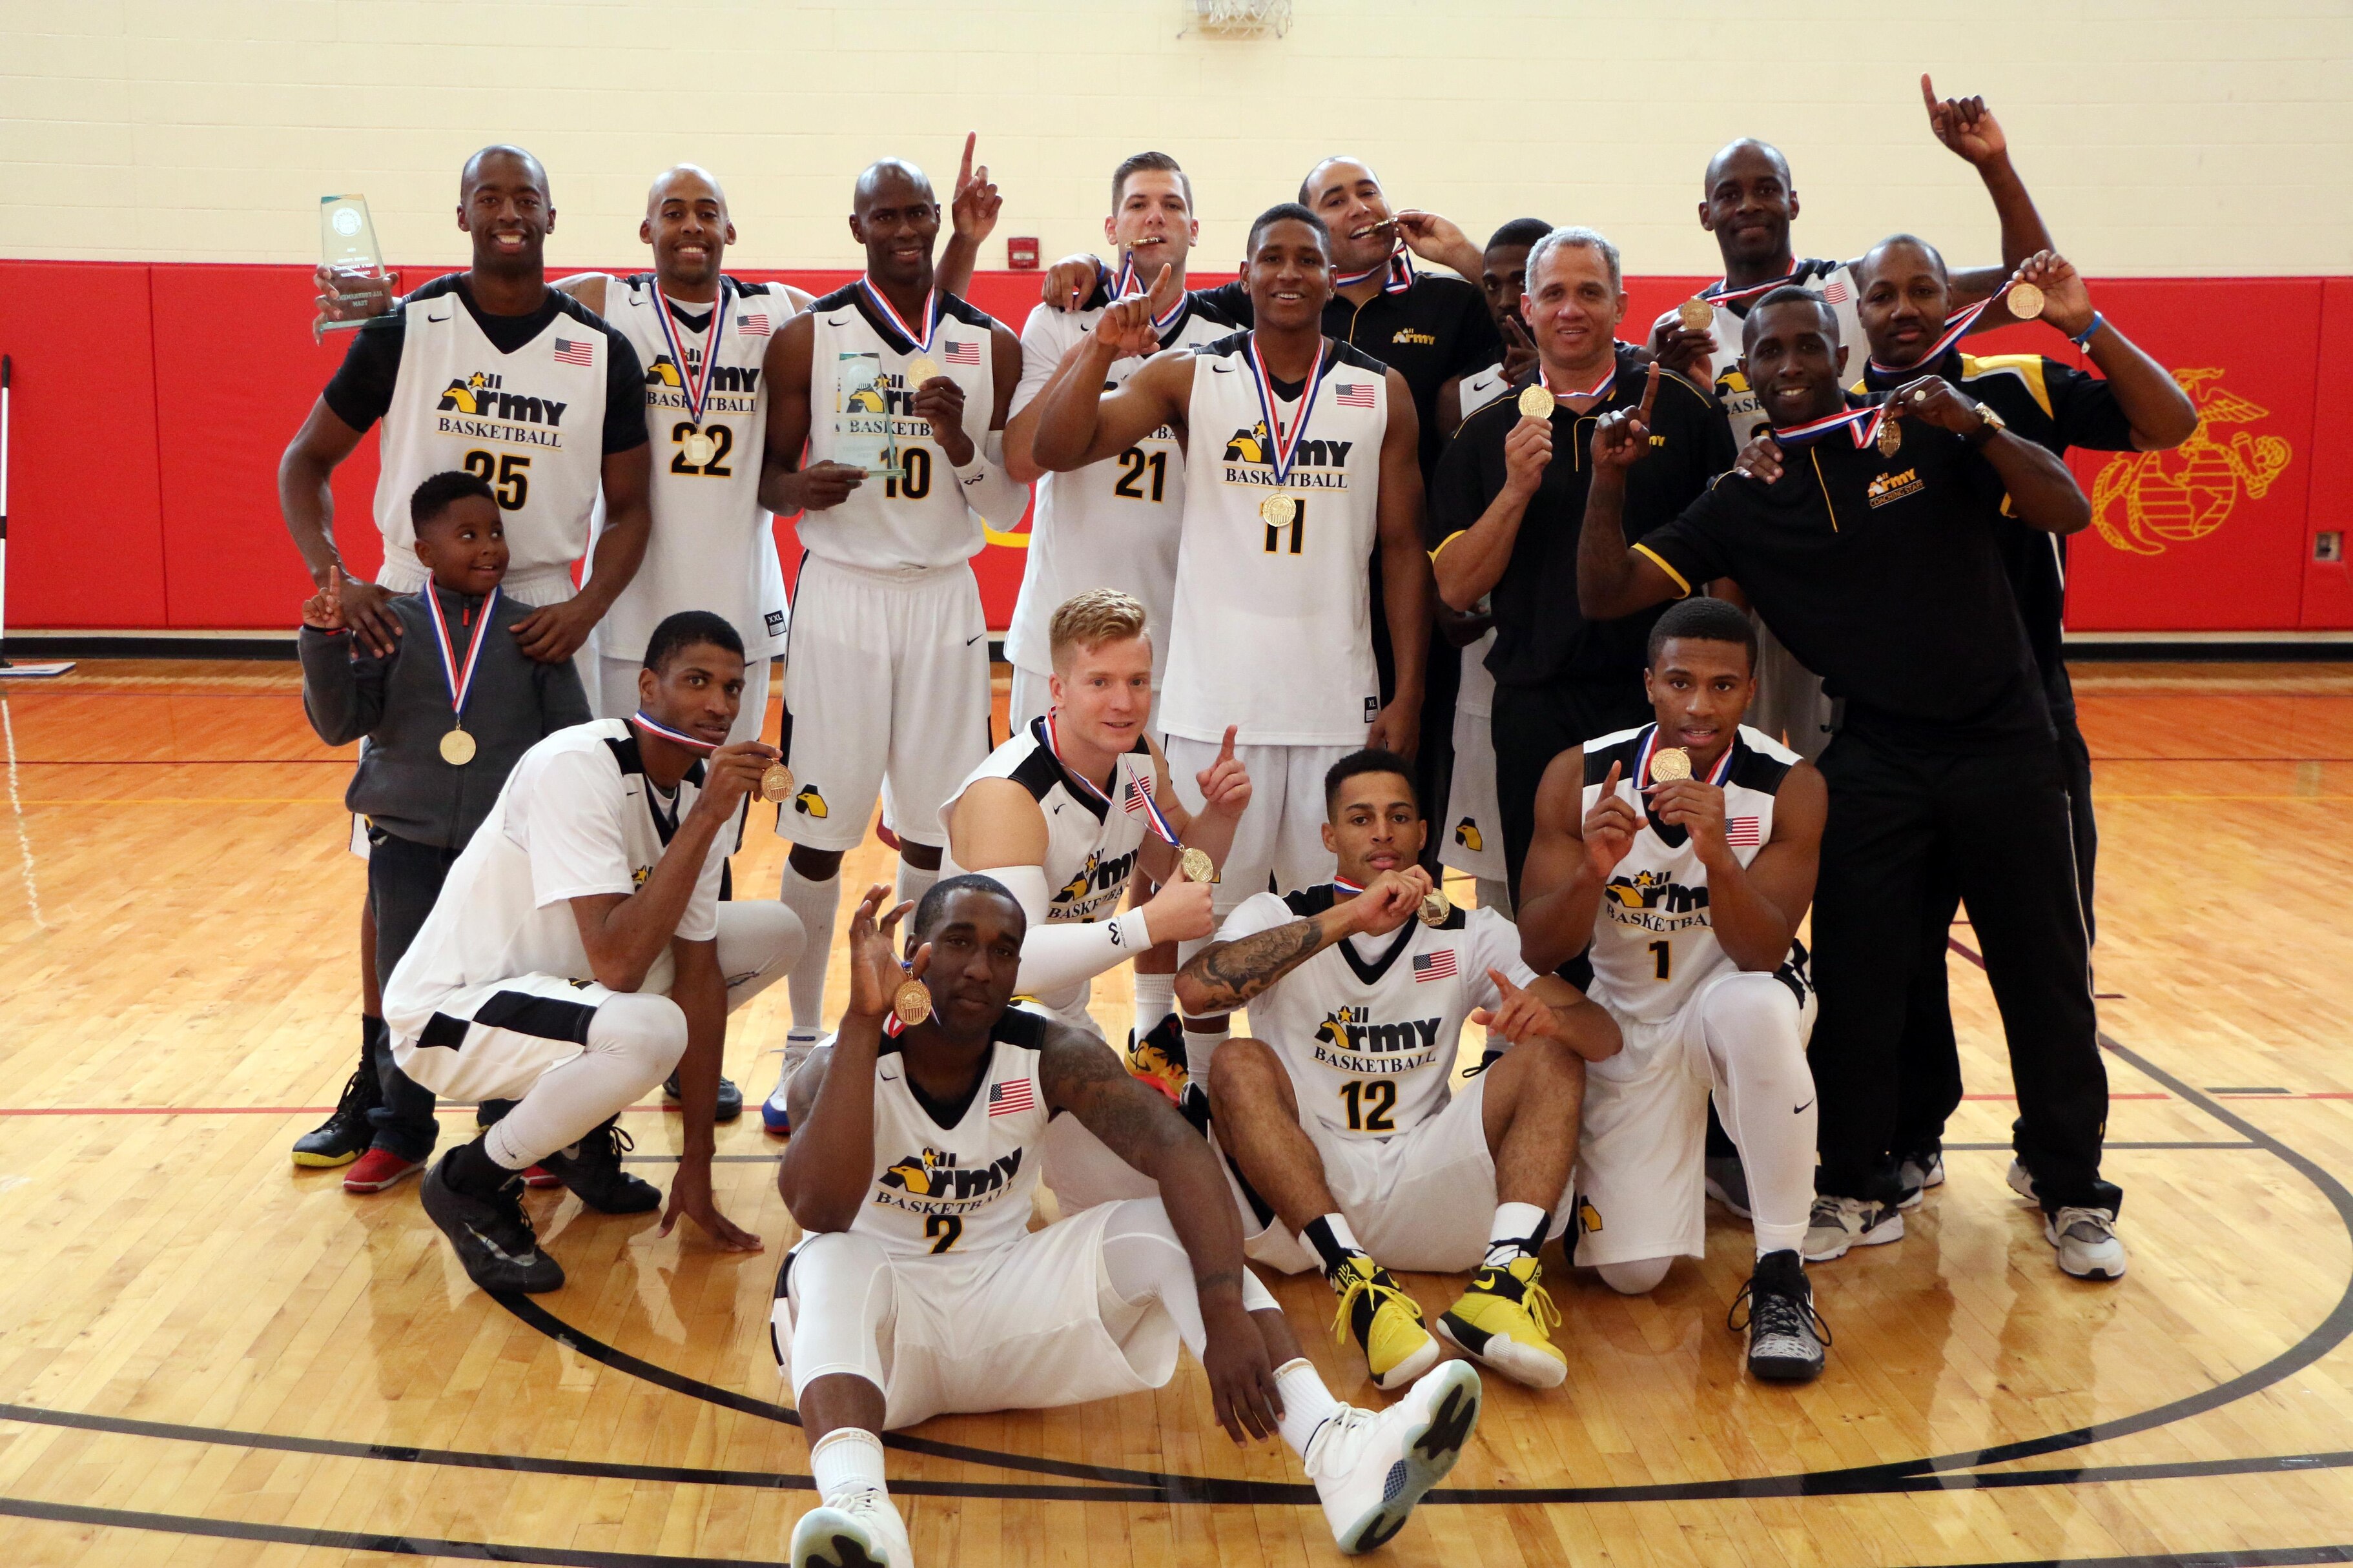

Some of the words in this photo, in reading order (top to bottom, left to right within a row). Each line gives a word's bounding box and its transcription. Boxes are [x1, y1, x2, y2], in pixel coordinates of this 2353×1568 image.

[437, 378, 568, 427] Army
[438, 417, 562, 447] BASKETBALL
[670, 422, 734, 479] 22
[463, 448, 532, 511] 25
[879, 444, 932, 501] 10
[1113, 445, 1168, 504] 21
[1869, 487, 1905, 507] COACHING
[1904, 480, 1924, 493] STAFF
[768, 613, 783, 624] XXL
[1368, 699, 1376, 708] XL
[1605, 875, 1710, 913] Arm
[1649, 940, 1672, 983] 1
[1314, 1012, 1442, 1053] Army
[1313, 1046, 1437, 1073] BASKETBALL
[1339, 1079, 1399, 1132] 12
[878, 1146, 1022, 1199] Army
[875, 1182, 1014, 1214] BASKETBALL
[924, 1214, 964, 1255] 2
